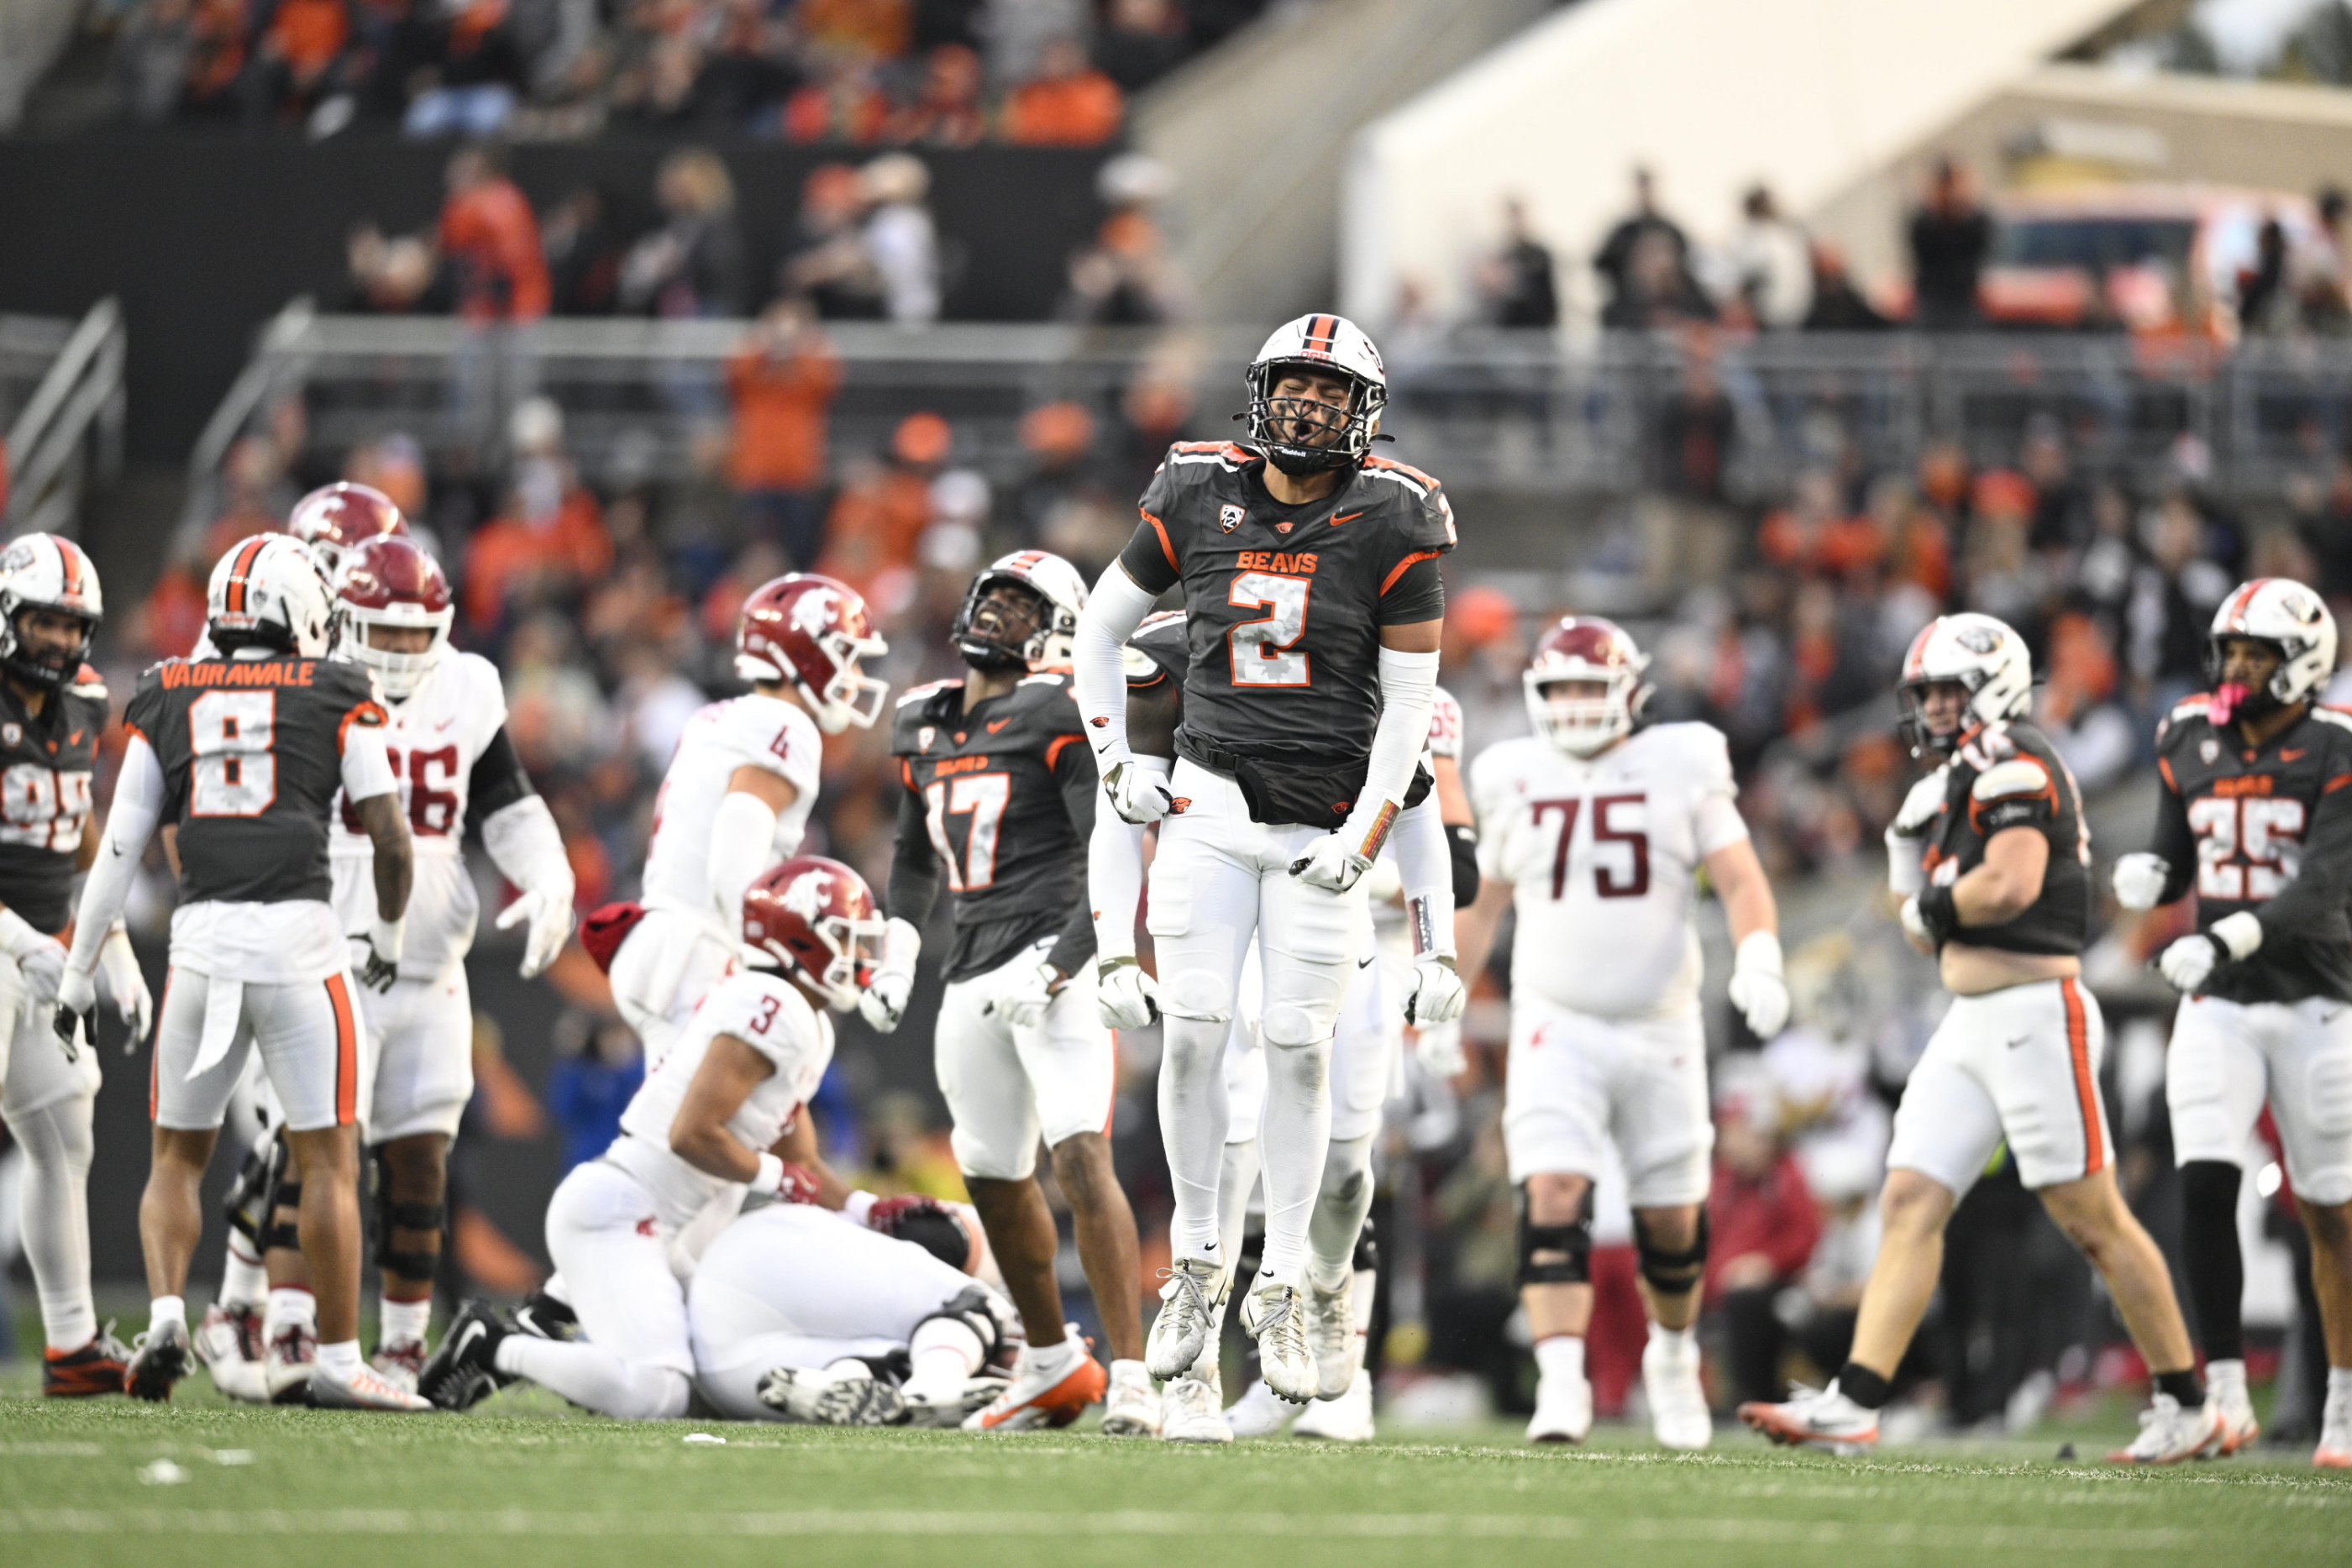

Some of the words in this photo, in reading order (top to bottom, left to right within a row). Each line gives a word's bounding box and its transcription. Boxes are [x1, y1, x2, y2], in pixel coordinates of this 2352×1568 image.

[1236, 551, 1318, 574] BEAVS
[160, 662, 316, 690] VADRAWALE
[1226, 569, 1312, 687] 2
[188, 688, 277, 818] 8
[769, 725, 788, 760] 4
[926, 772, 1011, 893] 17
[1531, 793, 1650, 901] 75
[2187, 797, 2306, 901] 25
[750, 994, 781, 1035] 3
